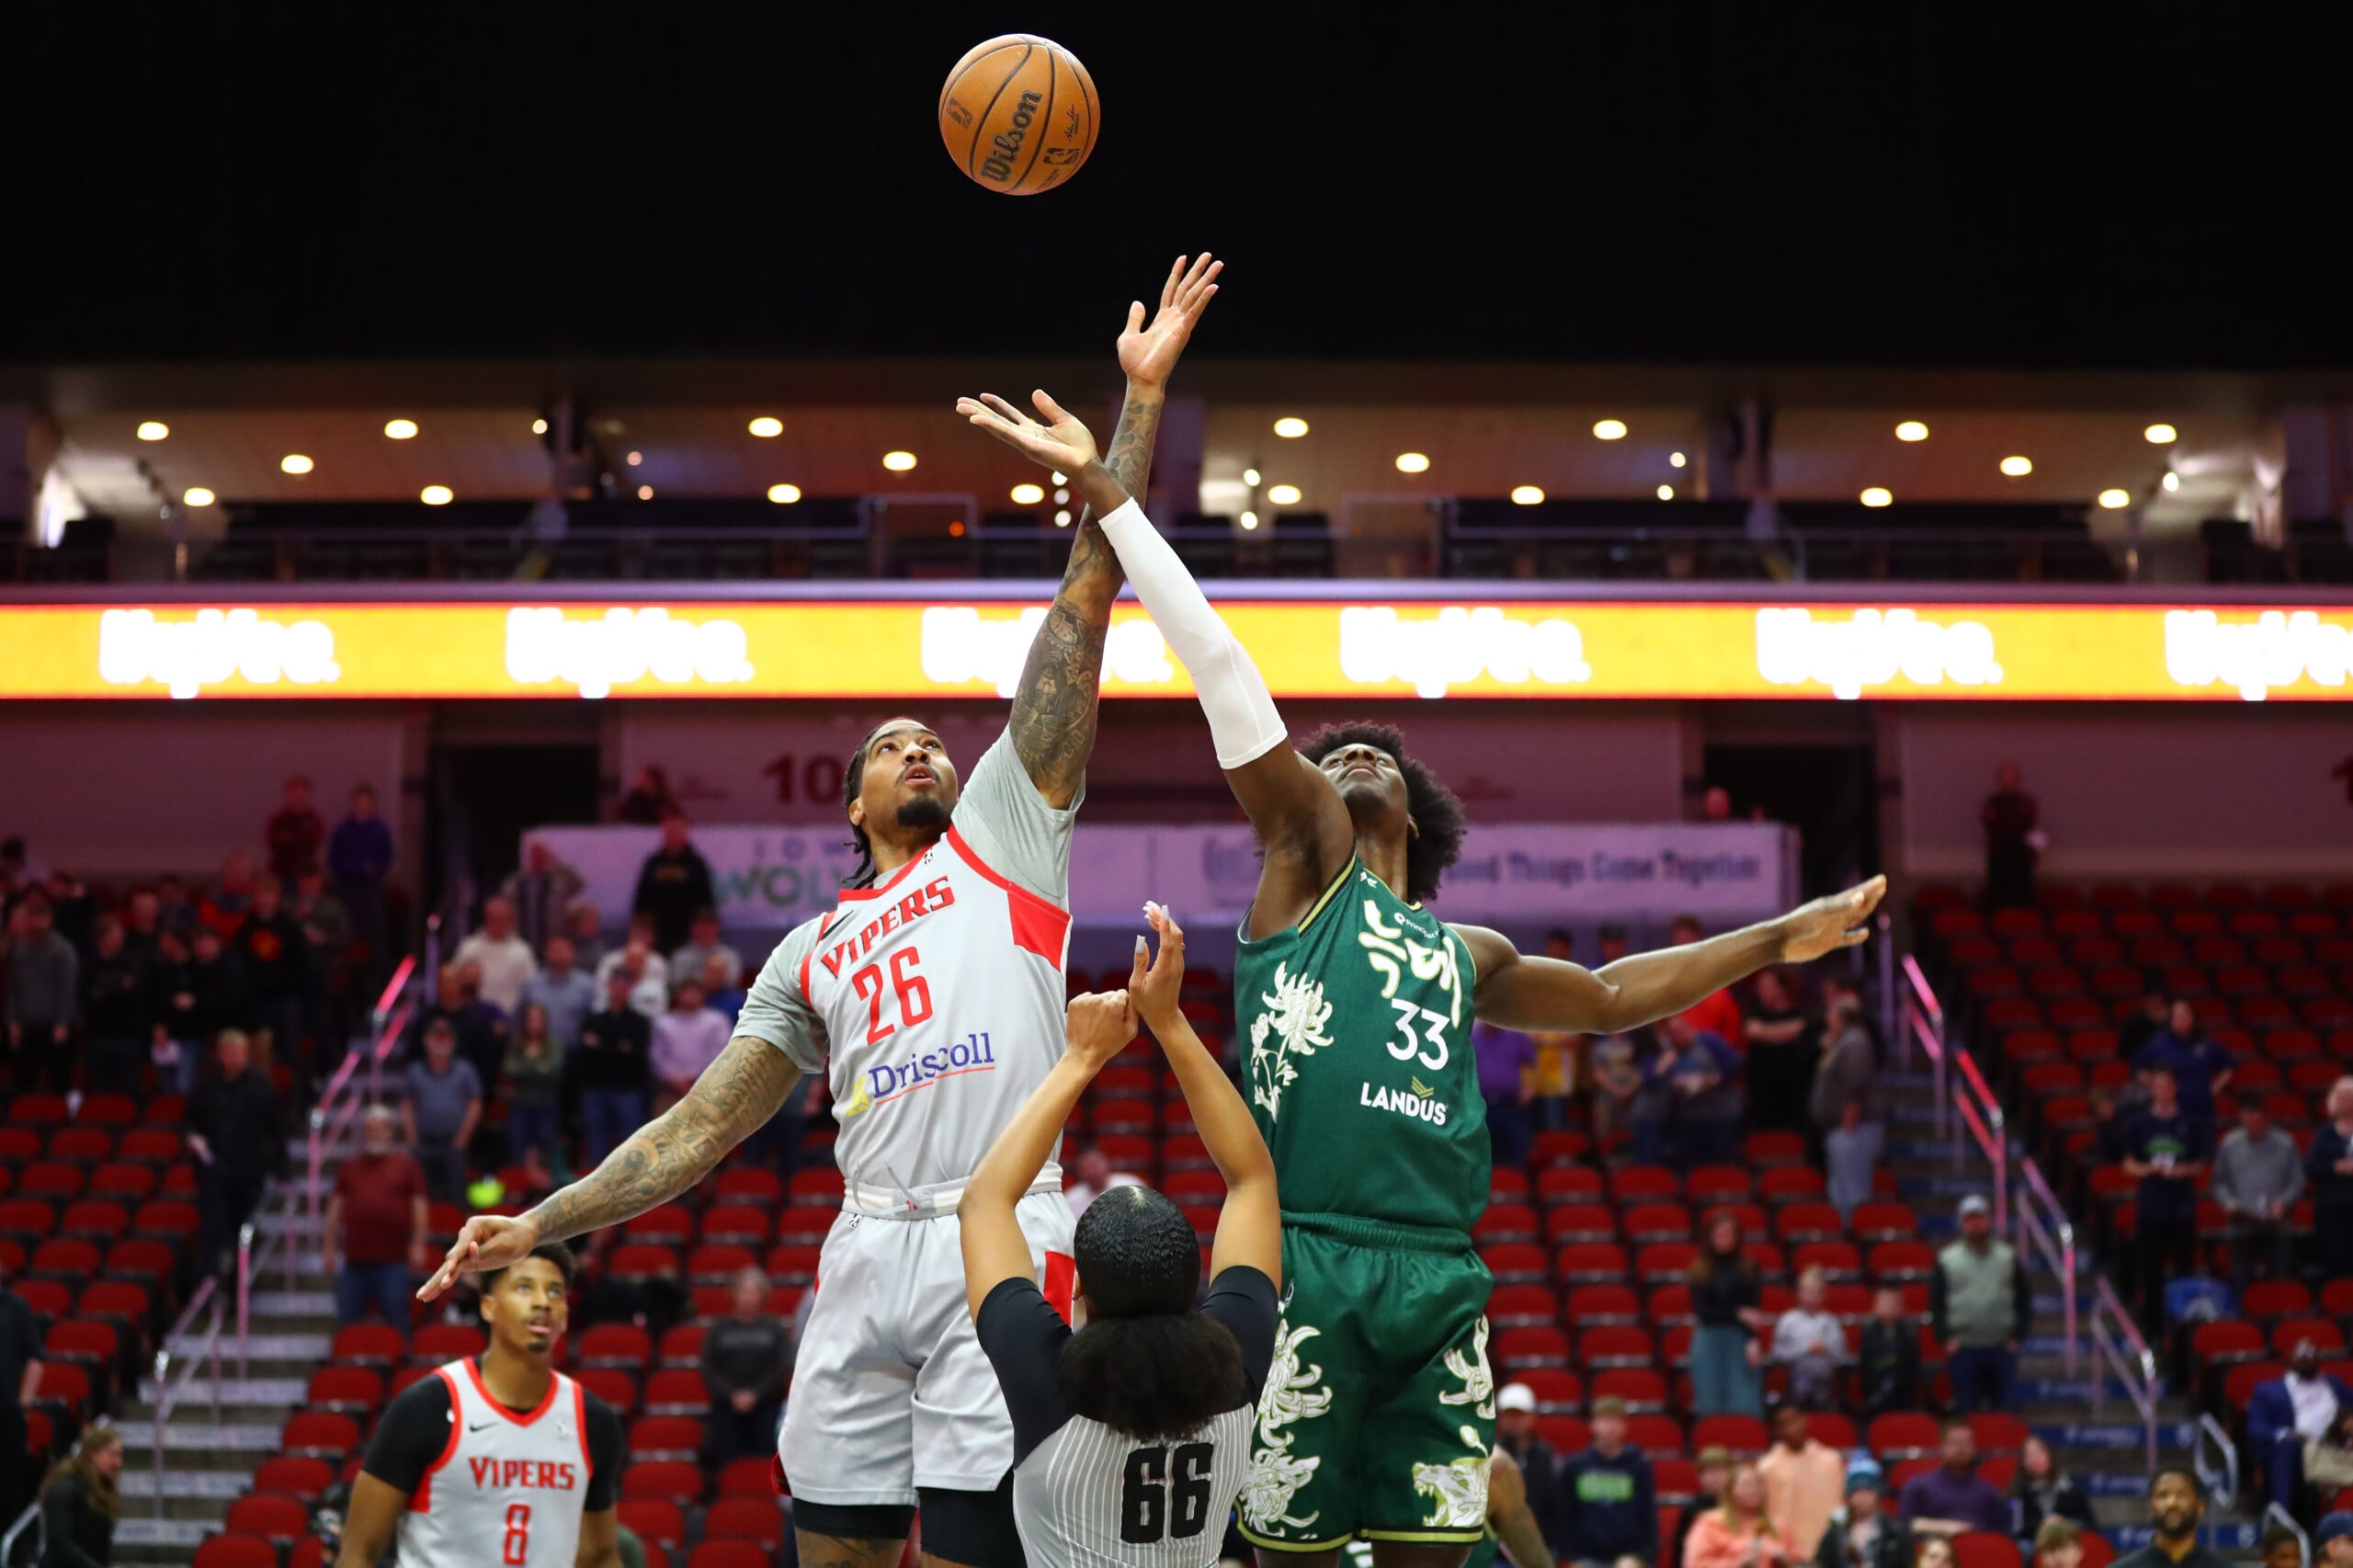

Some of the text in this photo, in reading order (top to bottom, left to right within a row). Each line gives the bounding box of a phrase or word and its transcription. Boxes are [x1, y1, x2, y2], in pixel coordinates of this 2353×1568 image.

[981, 90, 1042, 182] Wilson
[821, 875, 956, 979] VIPERS
[851, 946, 933, 1046] 26
[869, 1033, 995, 1098] Driscoll
[1386, 998, 1450, 1071] 33
[1360, 1082, 1447, 1126] LANDUS
[469, 1457, 574, 1490] VIPERS
[1120, 1442, 1214, 1544] 66
[504, 1504, 531, 1566] 8
